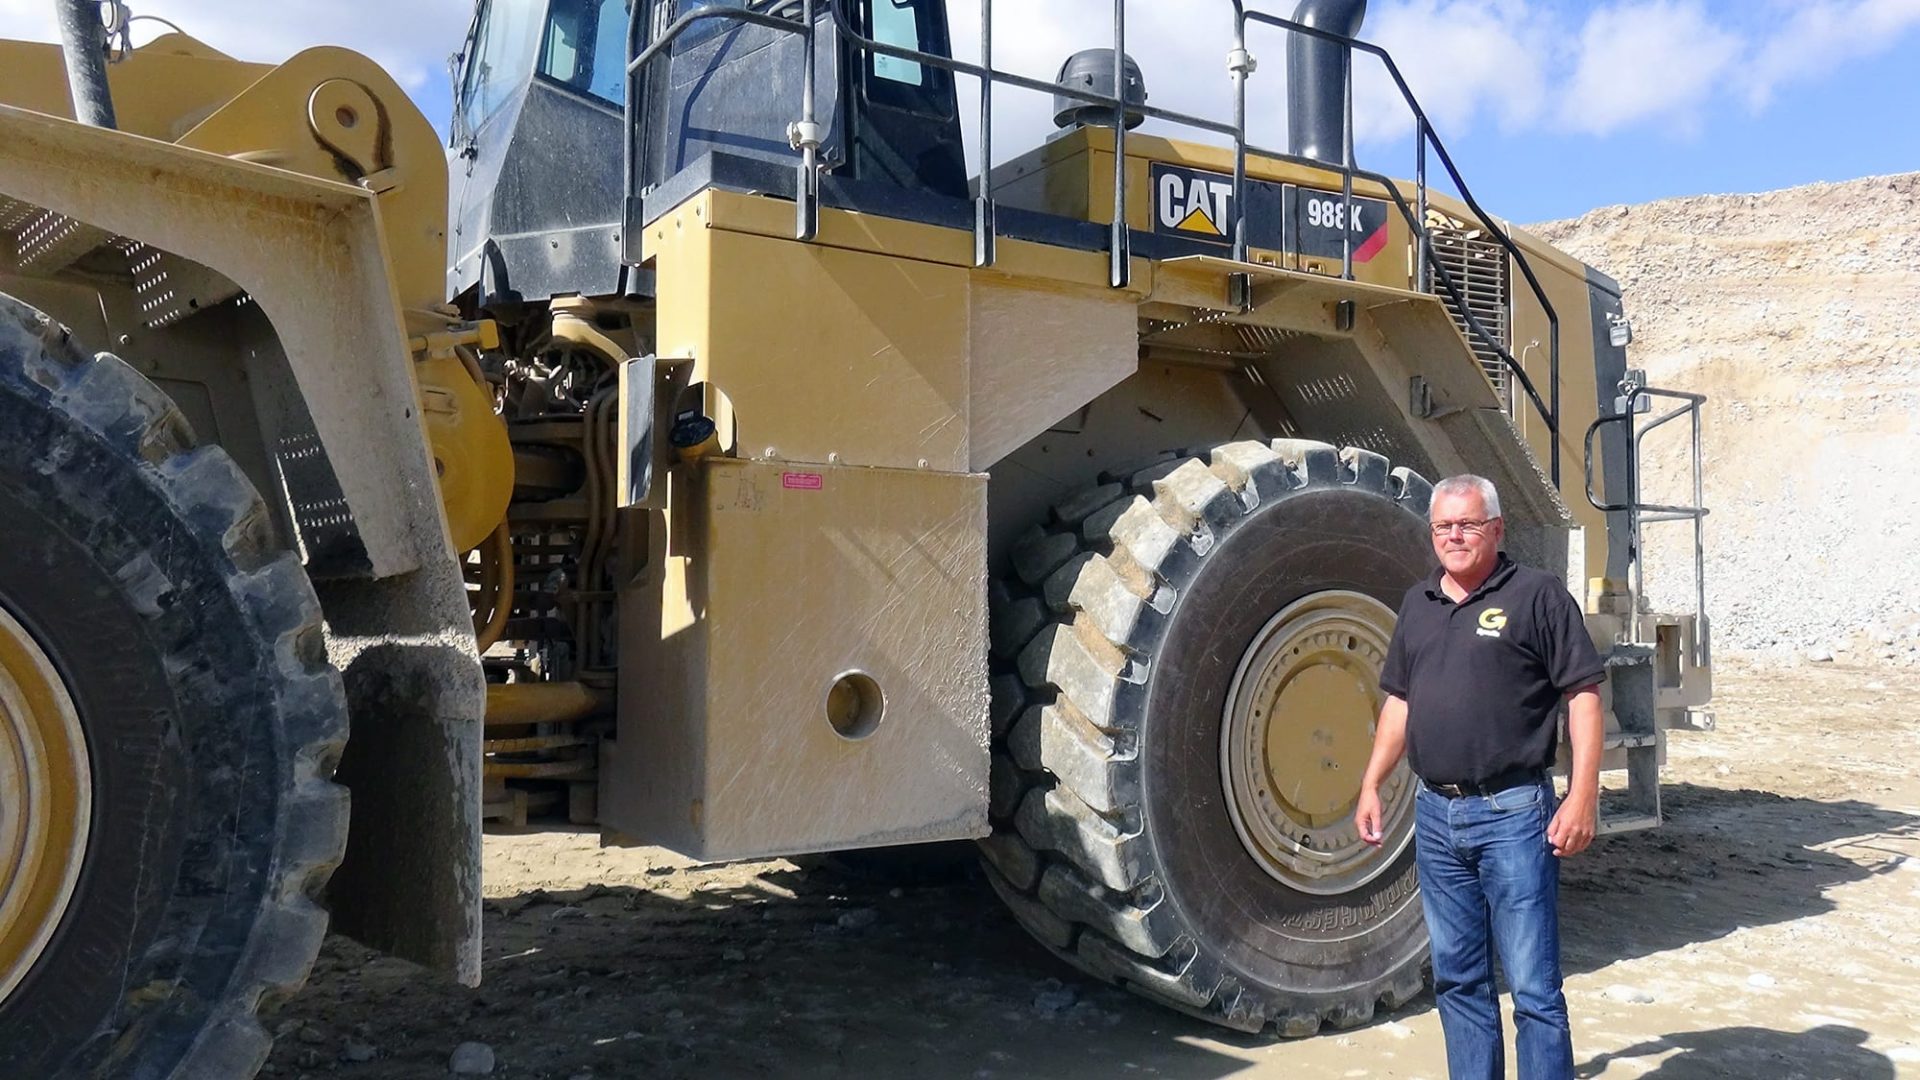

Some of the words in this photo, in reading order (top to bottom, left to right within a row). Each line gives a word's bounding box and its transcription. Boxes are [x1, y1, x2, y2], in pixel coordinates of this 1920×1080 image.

[1159, 173, 1233, 236] CAT
[1308, 198, 1363, 232] 988K
[1478, 607, 1508, 630] G
